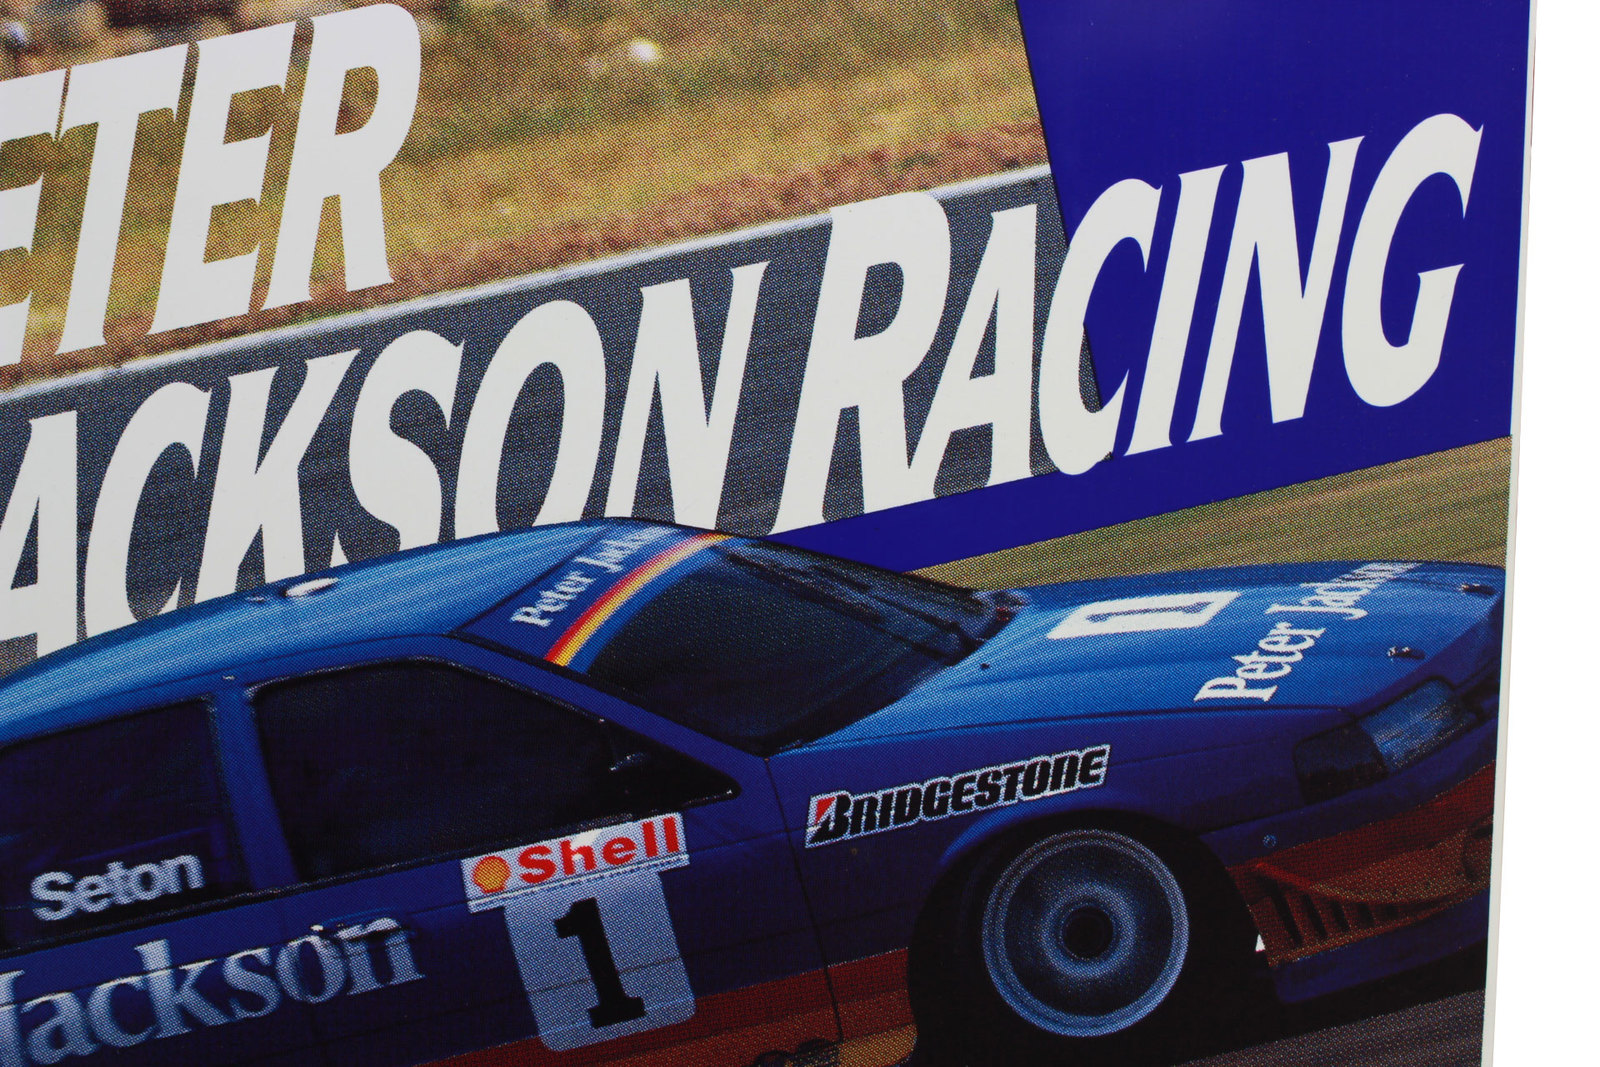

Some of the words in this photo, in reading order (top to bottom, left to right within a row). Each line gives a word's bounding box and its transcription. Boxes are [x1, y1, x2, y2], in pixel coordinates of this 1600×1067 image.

[766, 113, 1483, 536] RACING
[510, 569, 596, 628] Peter
[1193, 622, 1326, 702] Peter
[30, 854, 204, 922] Seton
[517, 817, 681, 885] Shell
[554, 897, 647, 1029] 1
